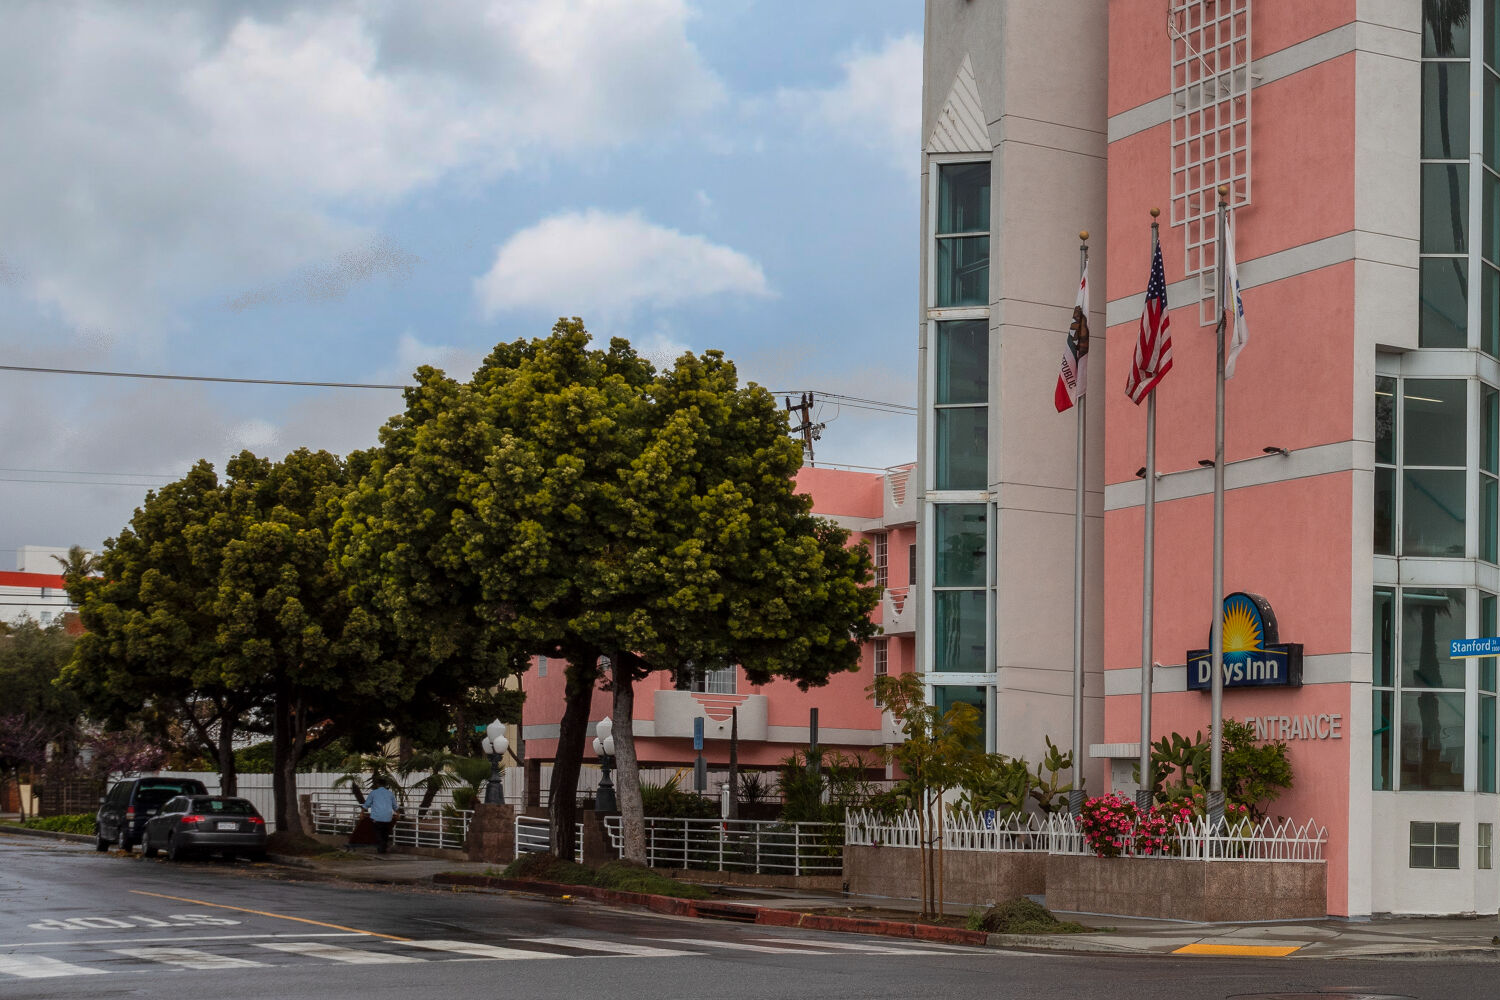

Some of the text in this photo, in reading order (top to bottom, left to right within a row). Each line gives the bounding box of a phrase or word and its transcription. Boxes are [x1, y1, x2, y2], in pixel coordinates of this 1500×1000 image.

[1452, 639, 1491, 653] Stanford
[1198, 657, 1279, 685] Dys Inn
[27, 913, 242, 930] STOP
